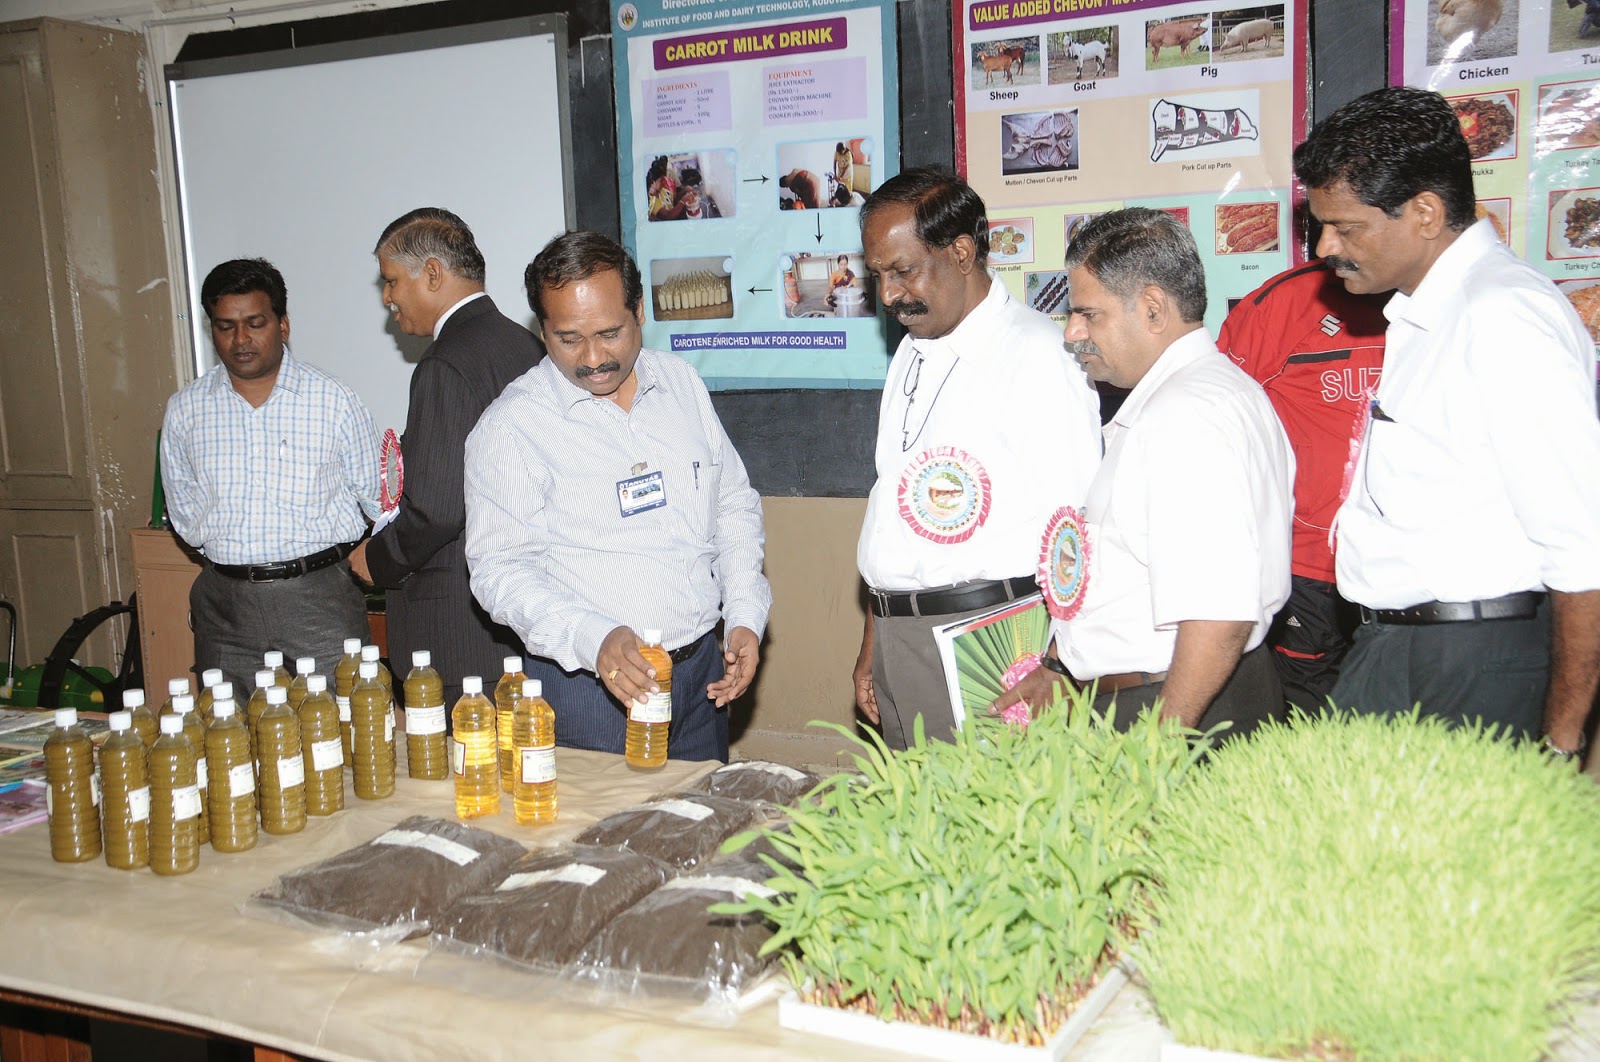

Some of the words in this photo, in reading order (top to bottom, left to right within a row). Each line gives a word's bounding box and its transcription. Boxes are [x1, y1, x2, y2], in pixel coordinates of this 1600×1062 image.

[642, 16, 680, 29] INSTITUTE
[681, 14, 691, 24] OF
[692, 12, 713, 22] FOOD
[714, 9, 730, 19] AND
[731, 6, 755, 17] DAIRY
[973, 5, 1010, 24] VALUE
[1012, 0, 1051, 19] ADDED
[665, 39, 729, 62] CARROT
[733, 34, 775, 54] MILK
[779, 27, 833, 49] DRINK
[1581, 53, 1600, 65] Tu
[768, 69, 813, 80] EQUIPMENT
[1200, 66, 1218, 79] Pig
[1458, 66, 1509, 80] Chicken
[783, 78, 815, 87] EXTRACTOR
[1073, 81, 1097, 92] Goat
[806, 92, 832, 100] MACHINE
[989, 91, 1019, 101] Sheep
[1181, 164, 1195, 172] Pork
[1565, 159, 1590, 168] Turkey
[1471, 168, 1494, 176] hukka
[1240, 263, 1260, 271] Bacon
[1564, 262, 1589, 271] Turkey
[673, 337, 712, 348] CAROTENE
[712, 335, 750, 347] ENRICHED
[751, 335, 771, 346] MILK
[771, 335, 788, 346] FOR
[789, 335, 812, 346] GOOD
[813, 335, 844, 346] HEALTH
